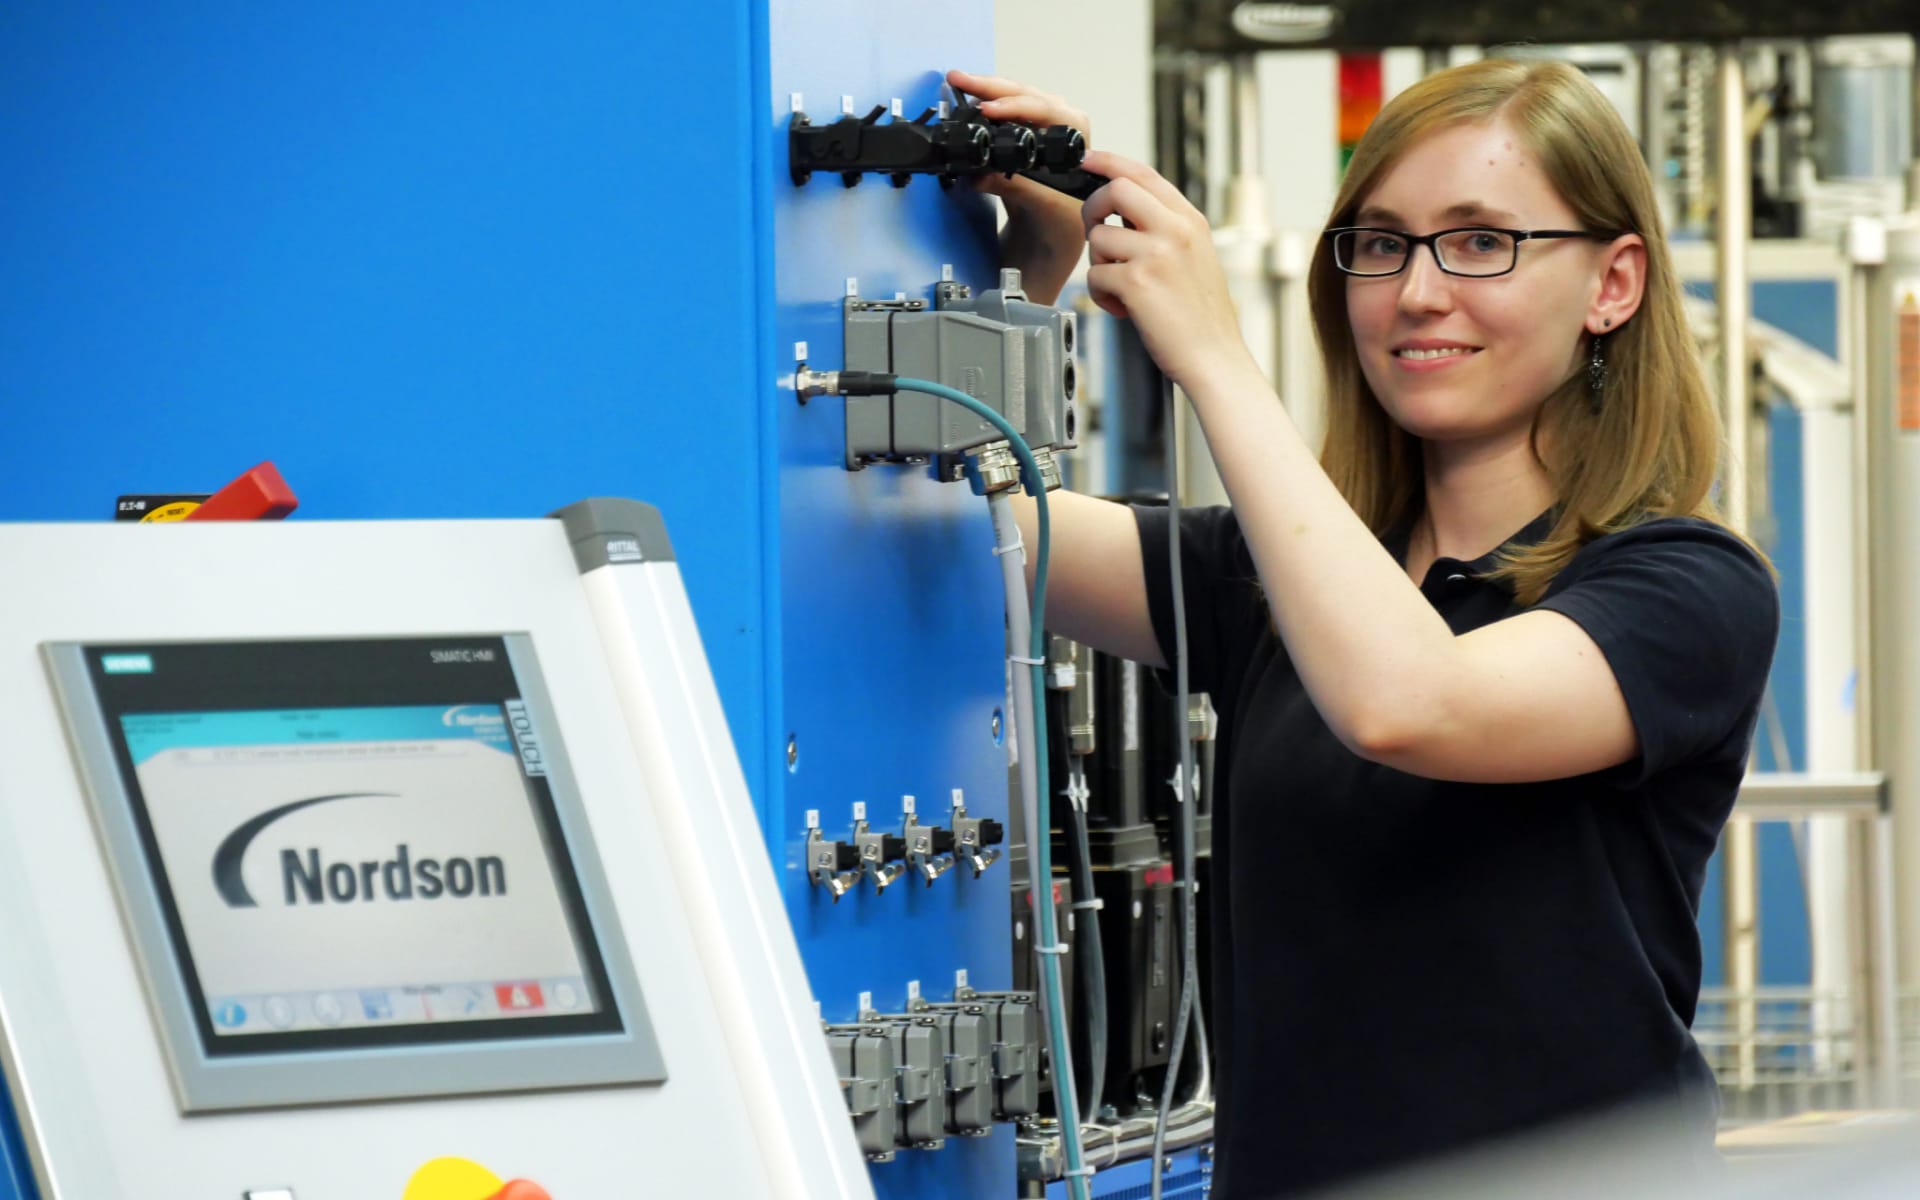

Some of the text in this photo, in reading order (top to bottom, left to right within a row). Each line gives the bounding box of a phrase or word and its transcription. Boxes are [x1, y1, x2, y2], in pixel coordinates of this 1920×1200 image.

[606, 539, 639, 554] RITTAL
[430, 648, 496, 663] SIMATIC HMI
[509, 703, 546, 775] TOUCH
[280, 844, 506, 905] Nordson
